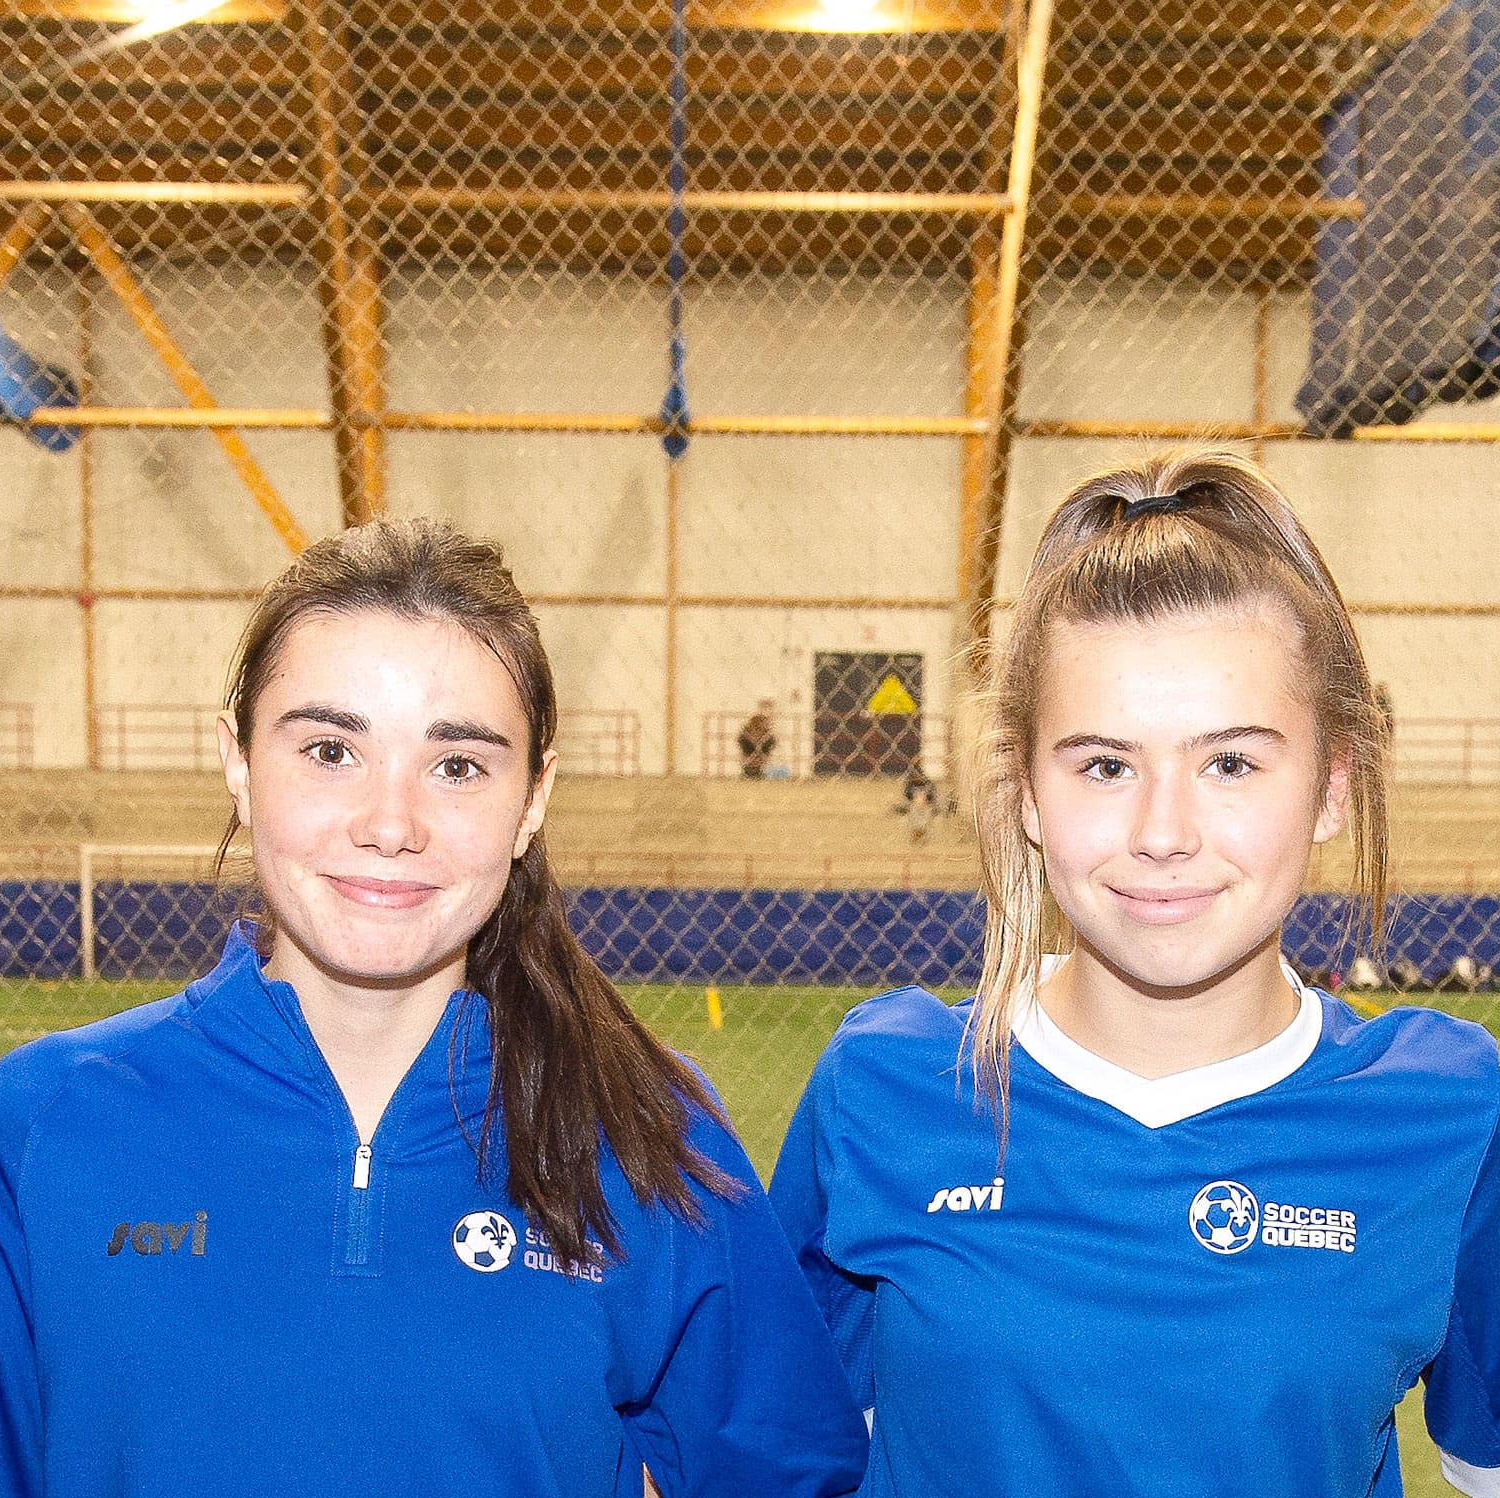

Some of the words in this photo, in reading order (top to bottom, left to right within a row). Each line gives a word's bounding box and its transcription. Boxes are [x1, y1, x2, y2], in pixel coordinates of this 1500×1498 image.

[927, 1177, 1005, 1213] savi
[107, 1209, 208, 1257] savi
[1263, 1201, 1356, 1229] SOCCER
